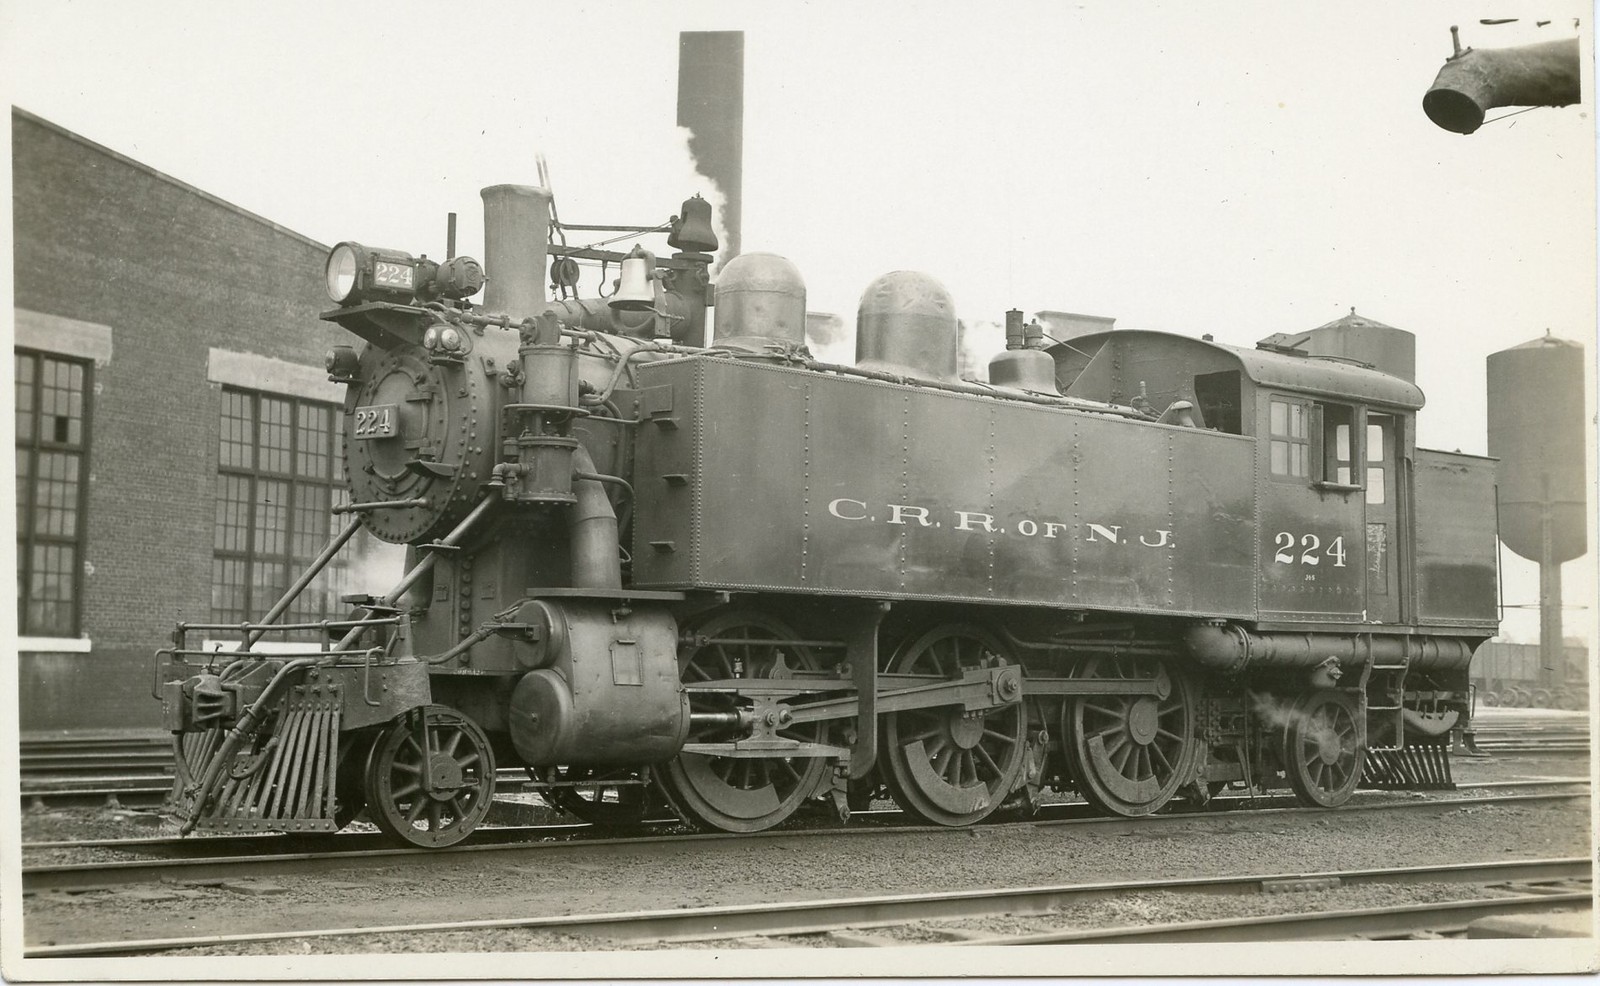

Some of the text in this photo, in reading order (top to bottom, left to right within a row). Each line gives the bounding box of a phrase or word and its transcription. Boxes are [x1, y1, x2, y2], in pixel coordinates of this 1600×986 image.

[376, 262, 412, 286] 224
[355, 408, 391, 434] 224
[1274, 531, 1347, 567] 224
